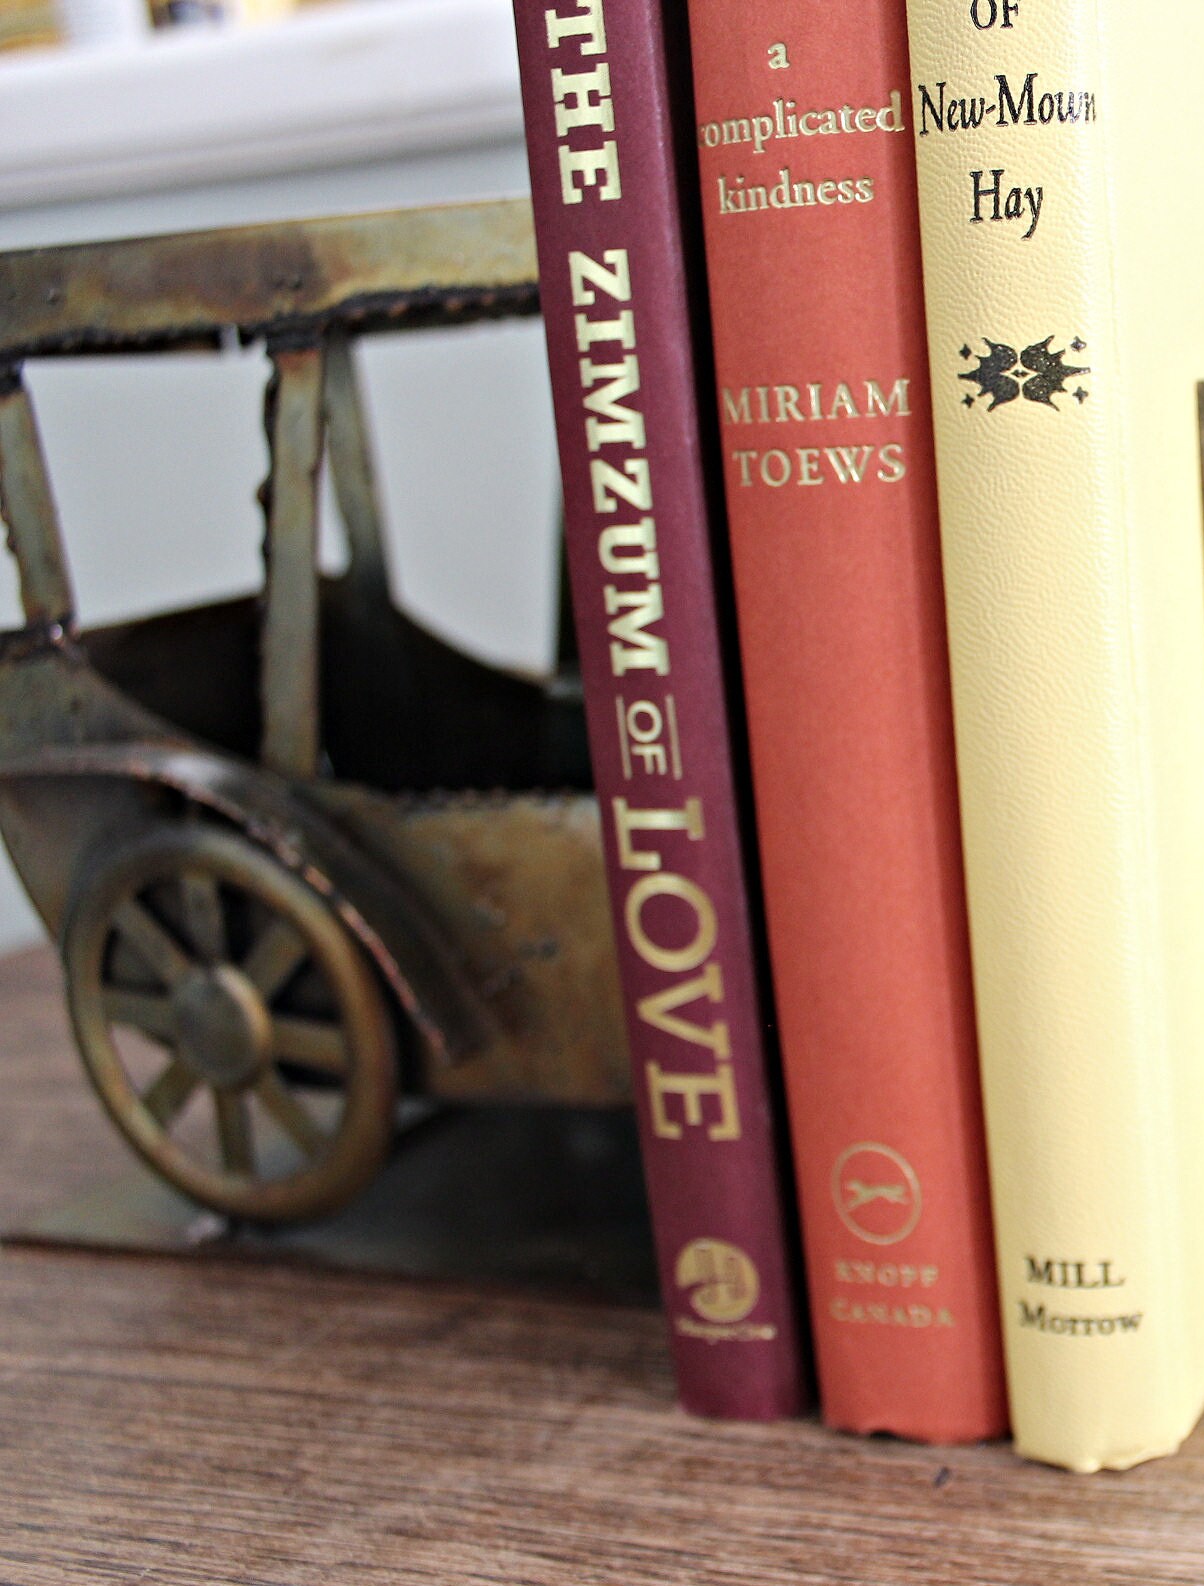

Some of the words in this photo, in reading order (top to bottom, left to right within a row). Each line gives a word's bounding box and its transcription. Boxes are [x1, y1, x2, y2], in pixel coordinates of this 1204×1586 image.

[767, 43, 790, 70] a
[544, 0, 622, 205] THE
[918, 73, 1097, 137] New-Mown
[718, 168, 874, 215] kindness
[970, 169, 1044, 241] Hay
[722, 379, 912, 426] MIRIAM
[568, 248, 671, 677] ZIMZUM
[733, 444, 906, 489] TOEWS
[625, 699, 667, 776] OF
[611, 797, 742, 1142] LOVE
[835, 1259, 940, 1288] KNOPF
[1026, 1254, 1125, 1288] MILL
[830, 1299, 956, 1329] CANADA
[1018, 1301, 1144, 1336] Morrow
